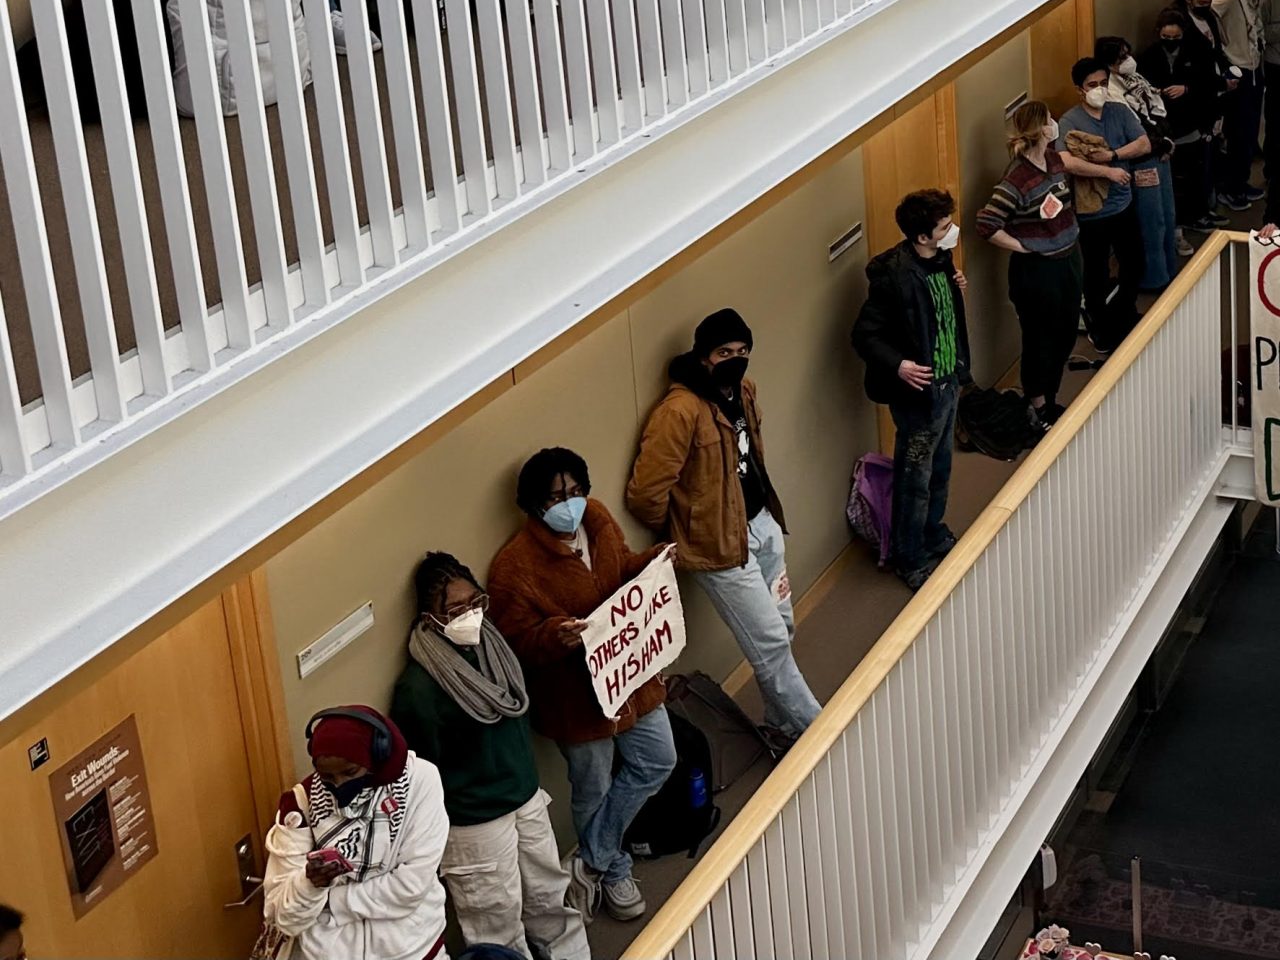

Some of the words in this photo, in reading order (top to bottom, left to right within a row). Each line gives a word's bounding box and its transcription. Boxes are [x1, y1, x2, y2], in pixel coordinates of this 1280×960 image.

[588, 621, 640, 679] OTHERS
[644, 585, 673, 629] LIKE
[611, 585, 644, 627] NO
[605, 620, 673, 705] HISHAM
[71, 769, 88, 788] Exit
